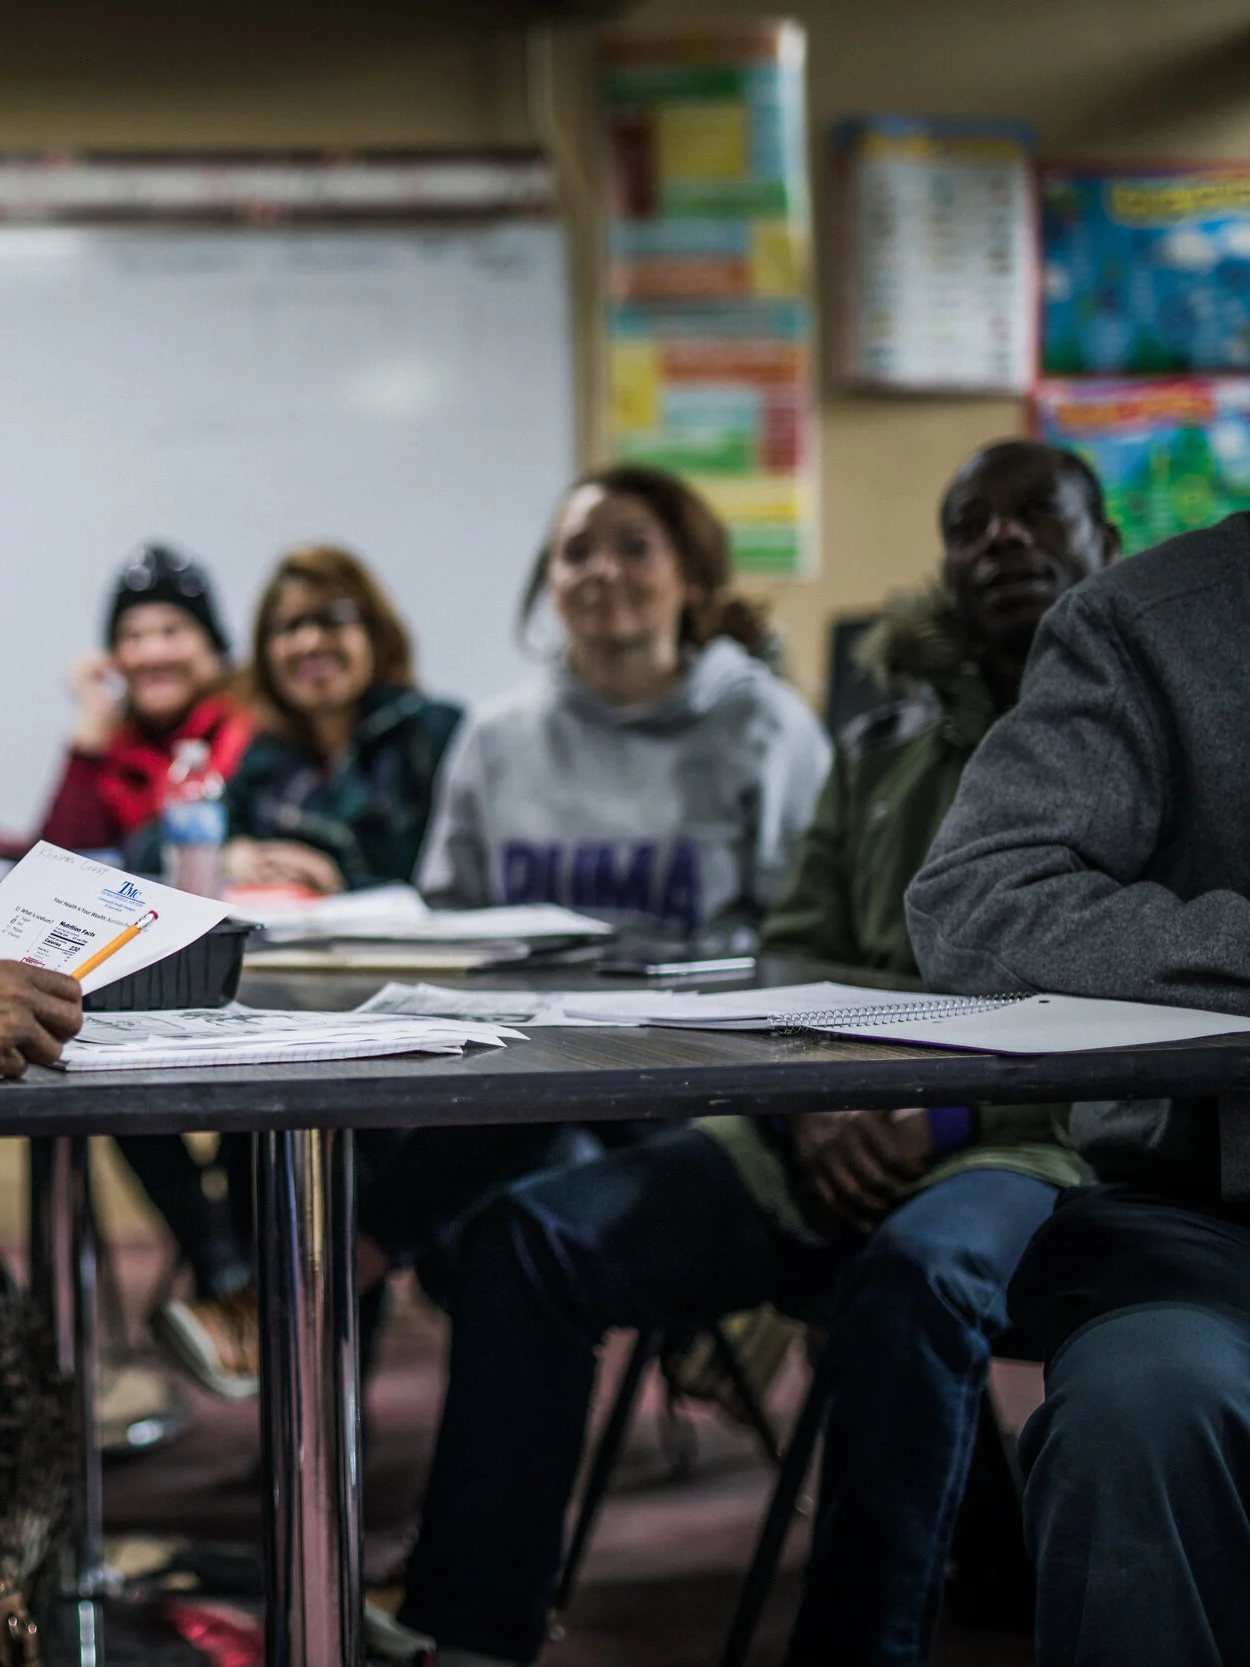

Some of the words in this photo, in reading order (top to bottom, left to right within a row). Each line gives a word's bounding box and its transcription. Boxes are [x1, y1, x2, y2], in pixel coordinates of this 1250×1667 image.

[117, 880, 142, 899] TMC
[63, 901, 78, 910] Health
[36, 915, 54, 924] sodium?
[59, 920, 82, 932] Nutrition
[81, 929, 96, 938] Facts
[44, 937, 62, 947] Calories
